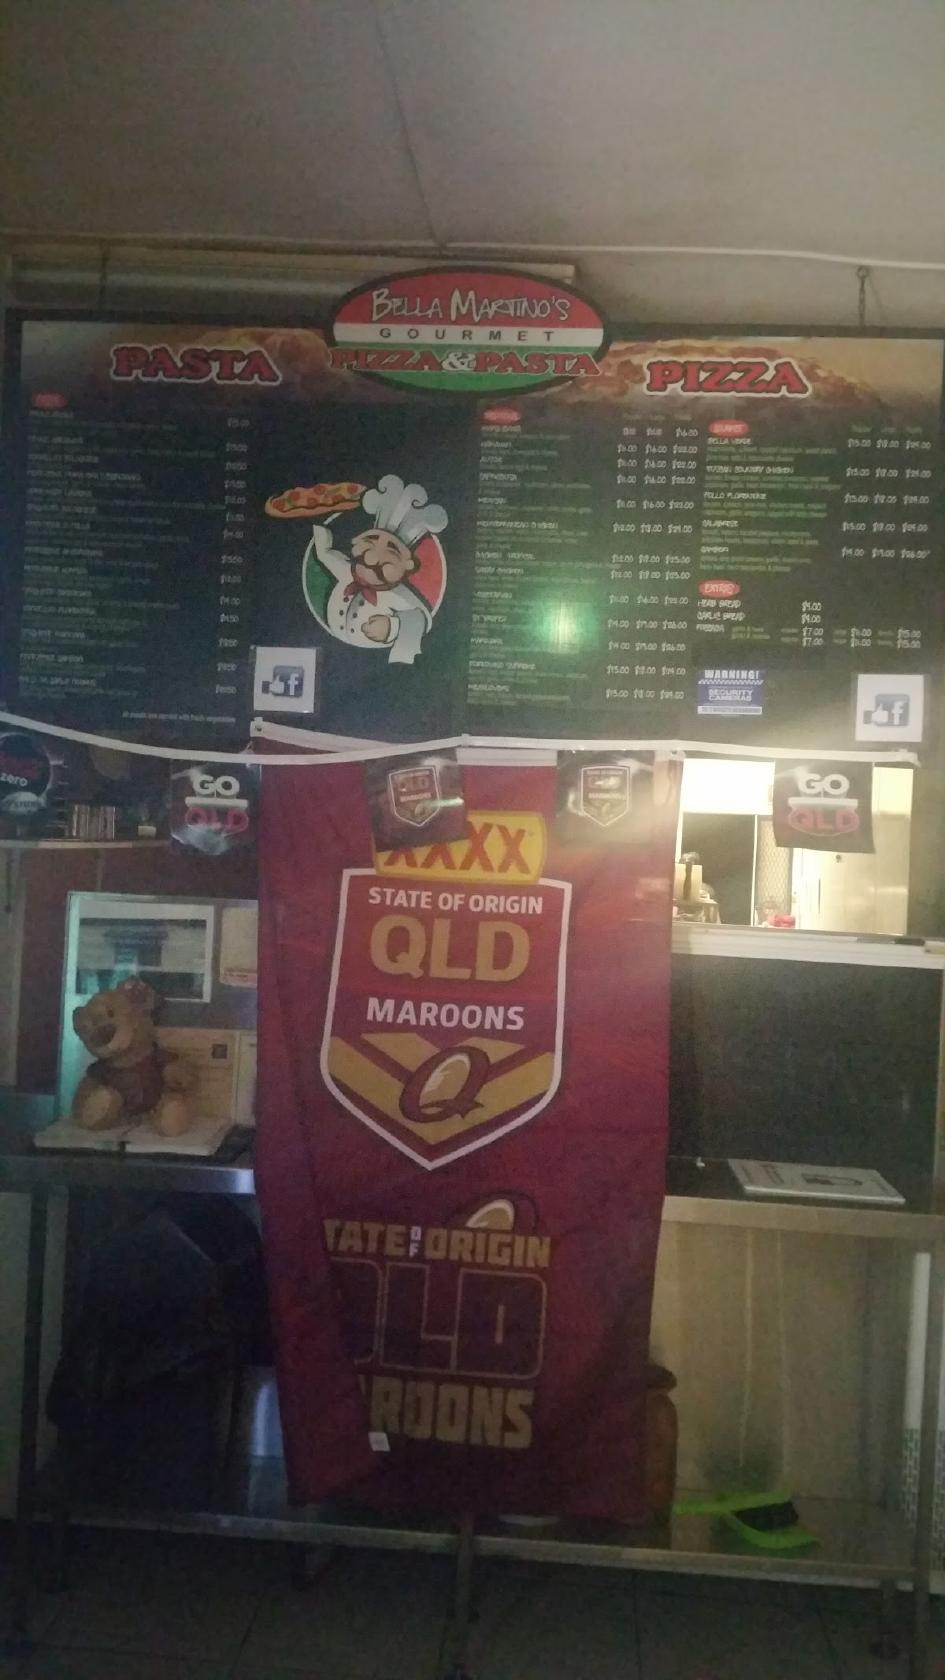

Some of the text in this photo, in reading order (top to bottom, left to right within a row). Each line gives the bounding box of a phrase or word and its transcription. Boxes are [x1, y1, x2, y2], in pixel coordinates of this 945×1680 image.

[372, 288, 570, 322] BELLA MARTINO'S
[380, 327, 555, 342] GOURMET
[111, 345, 281, 384] PASTA
[644, 357, 812, 398] PIZZA
[802, 627, 824, 637] $7.00
[802, 637, 824, 648] $7.00
[704, 669, 760, 680] WARNING!
[708, 688, 753, 696] SECURITY
[193, 775, 240, 796] GO
[798, 773, 850, 795] GO
[788, 808, 859, 834] QLD
[369, 887, 543, 914] STATE OF ORIGIN
[369, 915, 531, 982] QLD
[367, 997, 524, 1031] MAROONS
[425, 1228, 551, 1268] ORIGIN
[358, 1374, 534, 1449] ROONS
